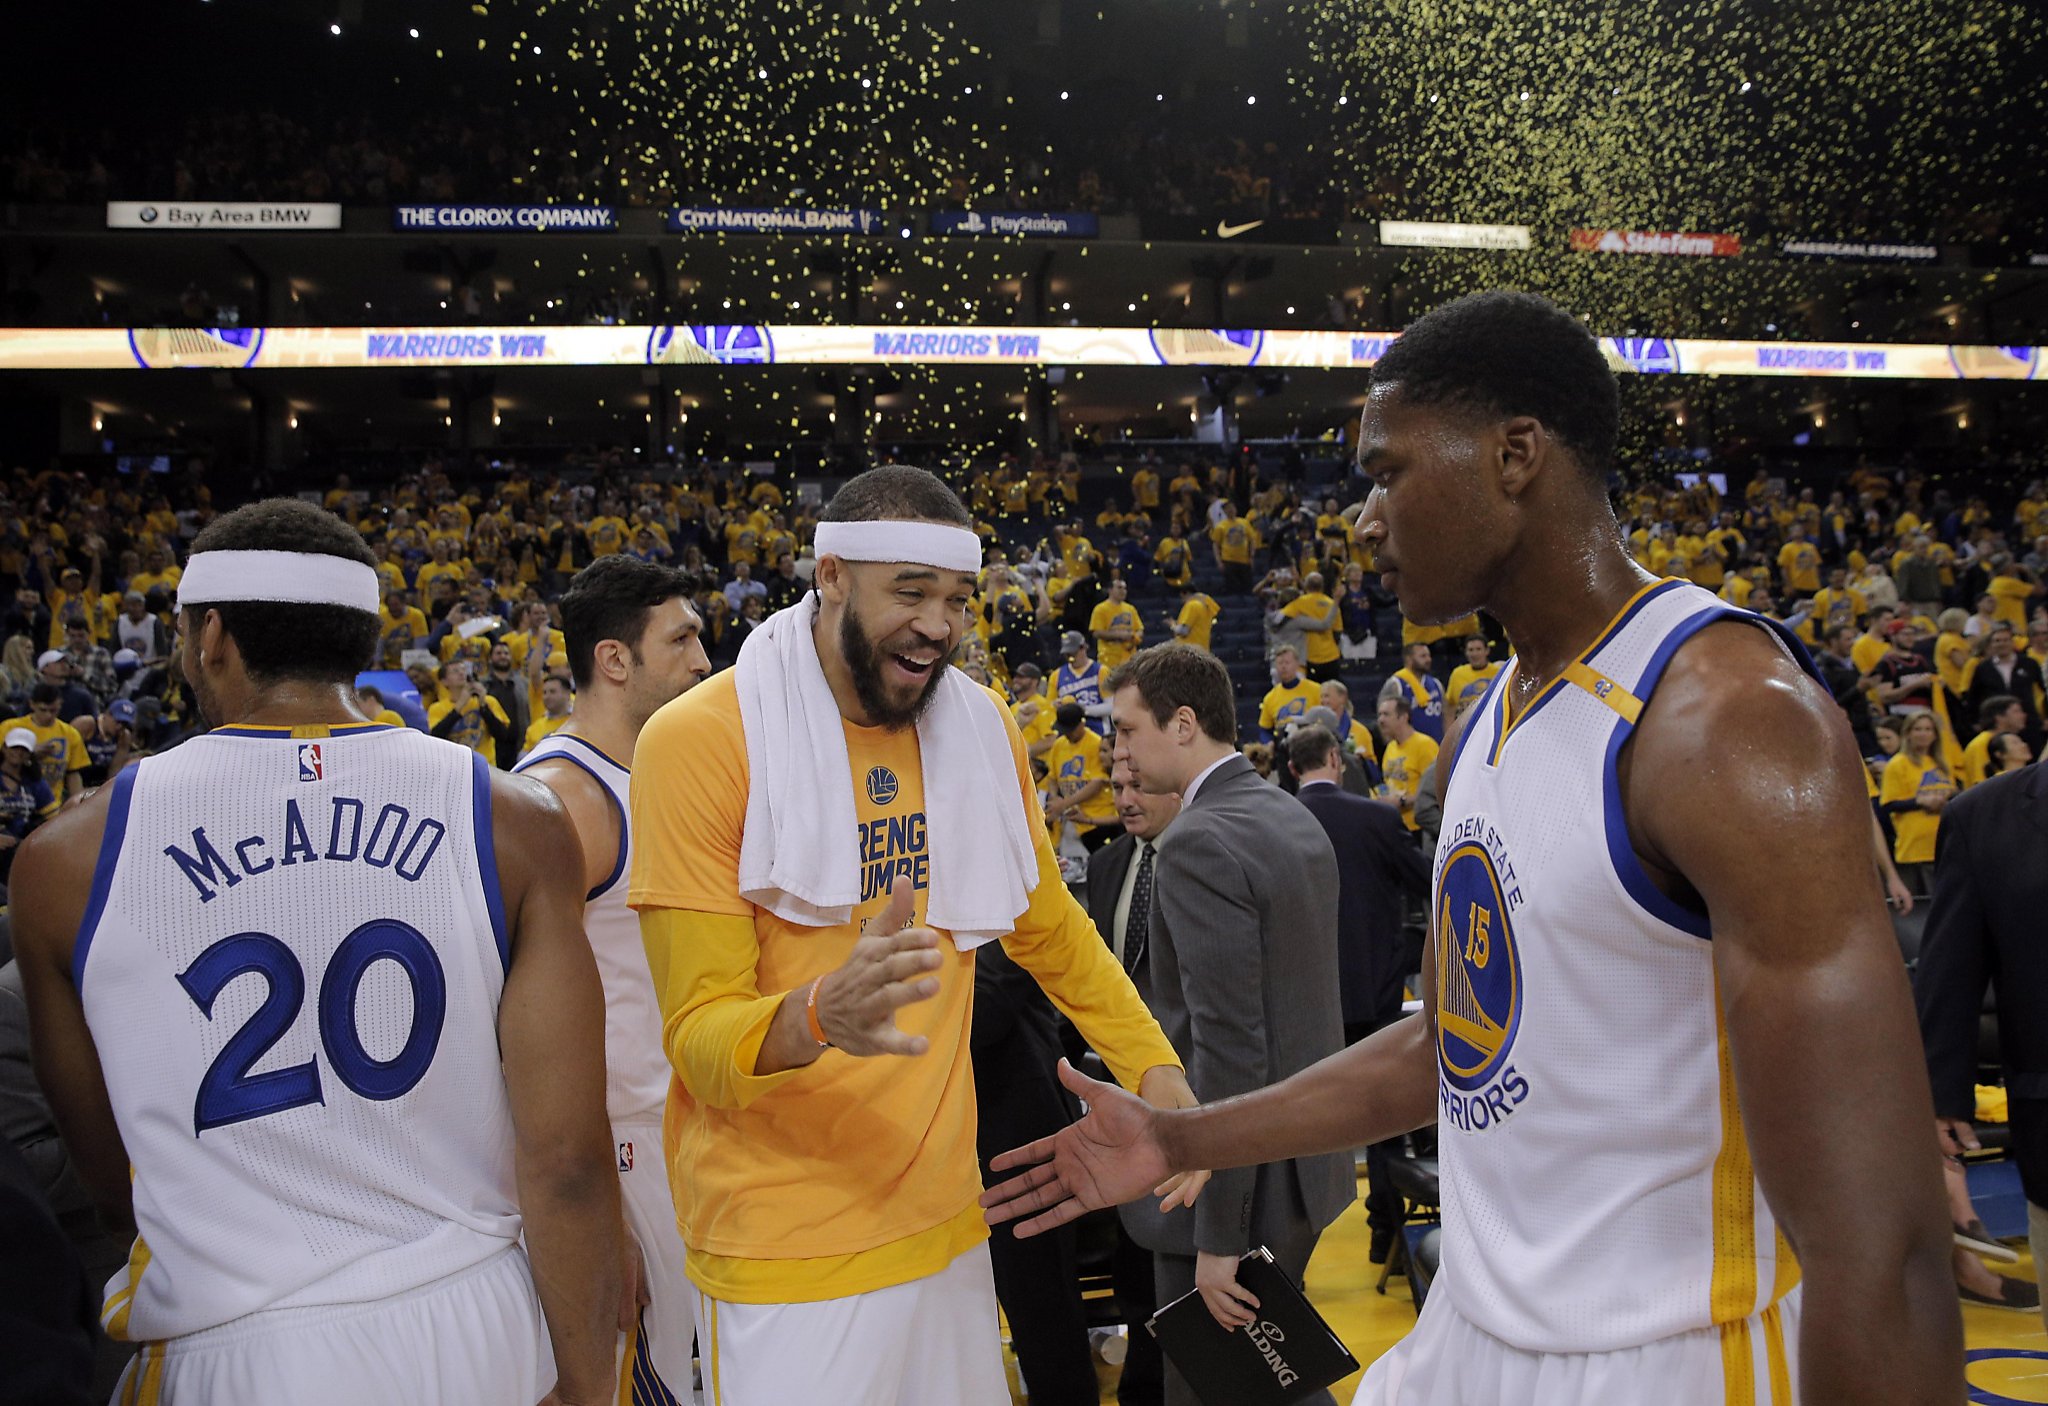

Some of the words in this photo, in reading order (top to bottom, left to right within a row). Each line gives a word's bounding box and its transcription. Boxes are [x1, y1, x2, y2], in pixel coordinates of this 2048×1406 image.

[168, 208, 203, 227] Bay
[209, 208, 254, 223] Area
[260, 208, 311, 223] BMW
[398, 207, 436, 226] THE
[437, 207, 514, 226] CLOROX
[516, 208, 610, 227] COMPANY
[805, 210, 855, 229] BANK
[990, 215, 1068, 235] PlayStation
[368, 334, 494, 358] WARRIORS
[500, 334, 546, 358] WIN
[873, 333, 992, 356] WARRIORS
[996, 334, 1040, 357] WIN
[1757, 347, 1848, 369] WARRIORS
[163, 796, 446, 903] McADOO
[858, 812, 926, 864] RENG
[860, 854, 930, 903] UMBE
[1485, 826, 1524, 913] STATE
[1464, 901, 1490, 969] 15
[174, 918, 447, 1139] 20
[1440, 1063, 1530, 1131] RRIORS
[1243, 1320, 1300, 1388] ALDING
